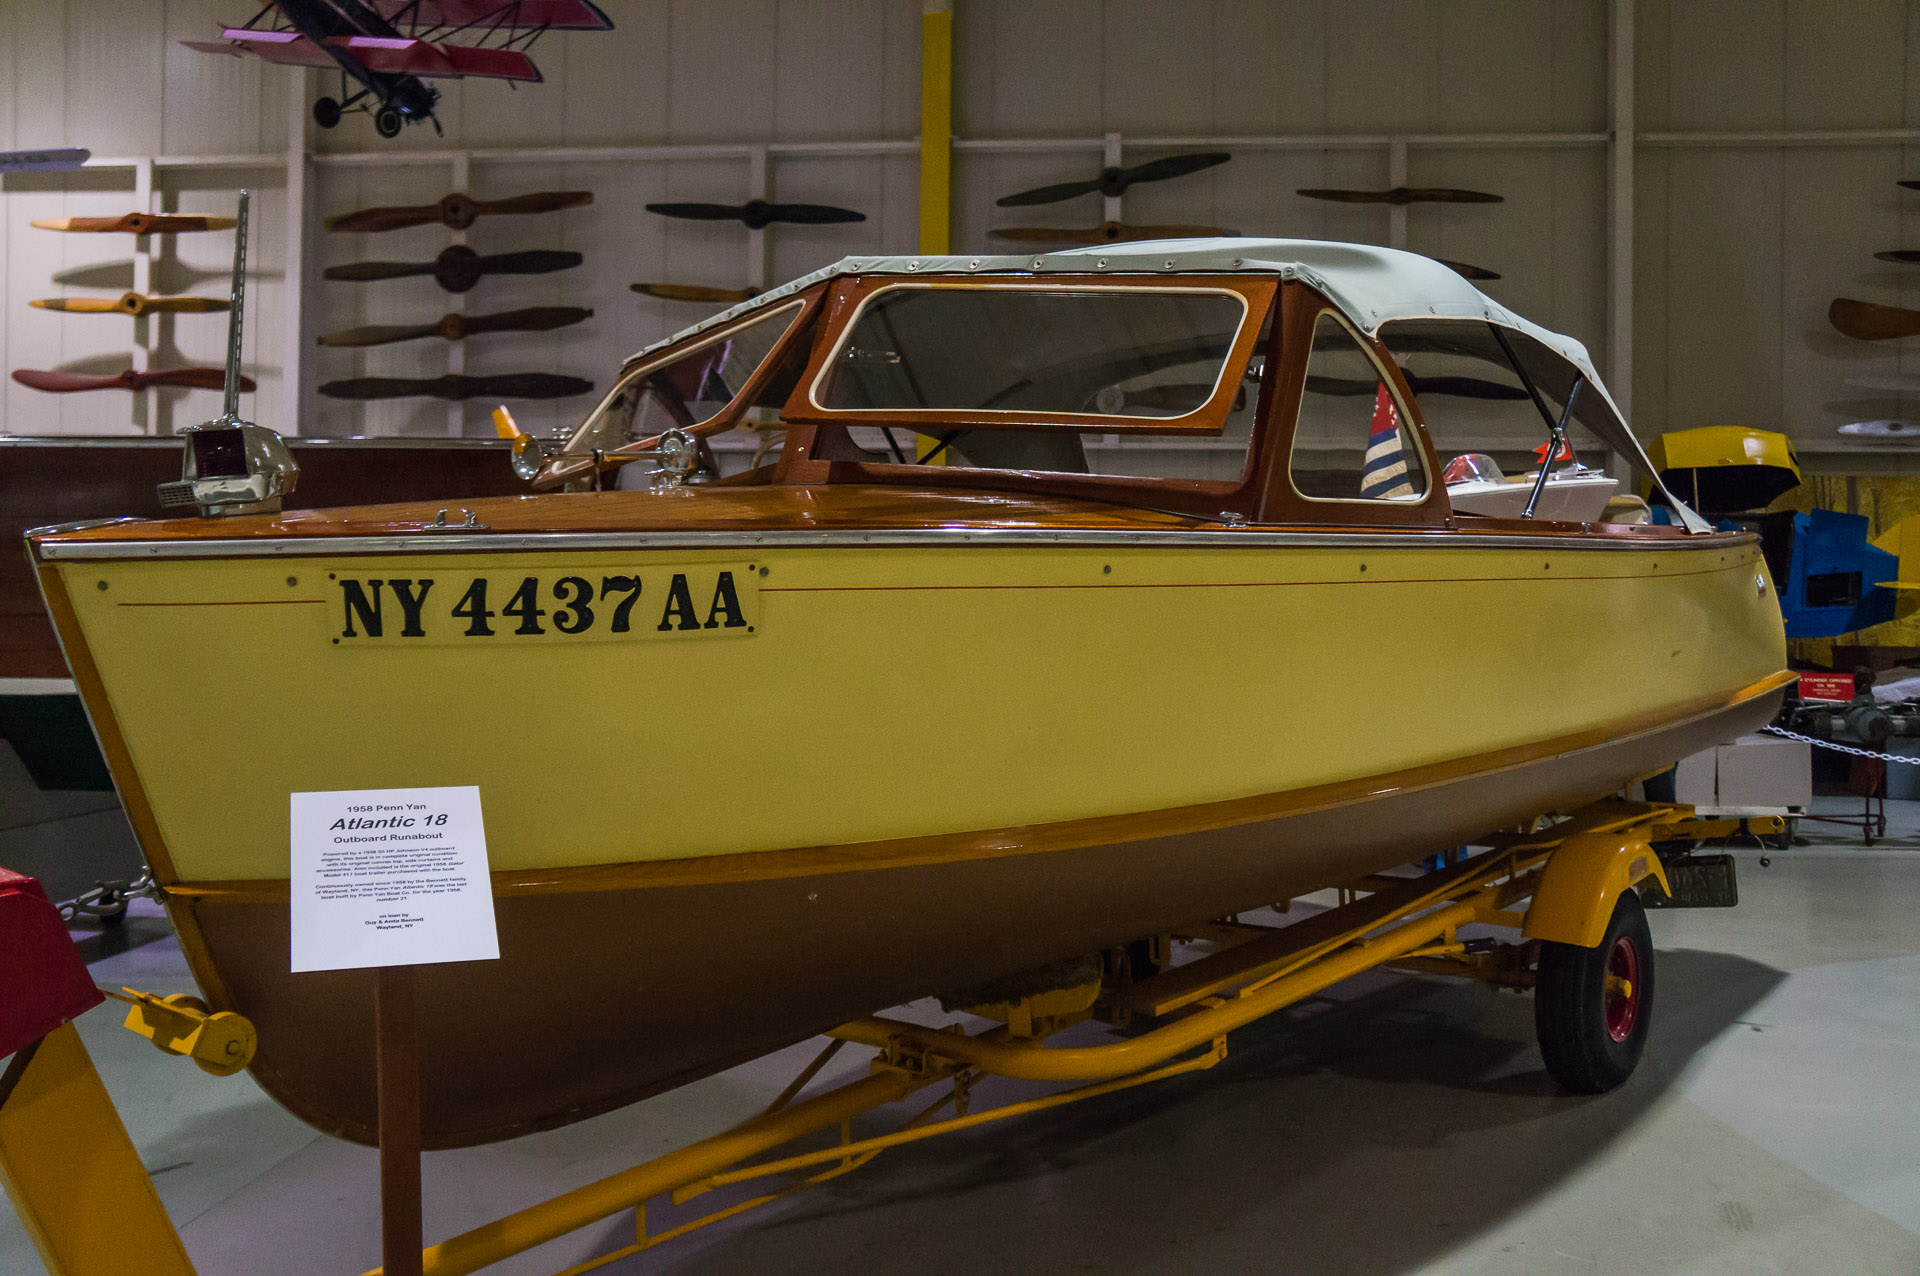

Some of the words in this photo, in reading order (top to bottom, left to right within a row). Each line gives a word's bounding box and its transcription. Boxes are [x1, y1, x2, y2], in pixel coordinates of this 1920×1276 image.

[339, 579, 434, 637] NY
[451, 575, 642, 637] 4437
[657, 571, 747, 631] AA
[330, 816, 416, 830] Atlantic
[424, 814, 448, 826] 18
[333, 835, 387, 844] Outboard
[390, 832, 443, 841] Runabout
